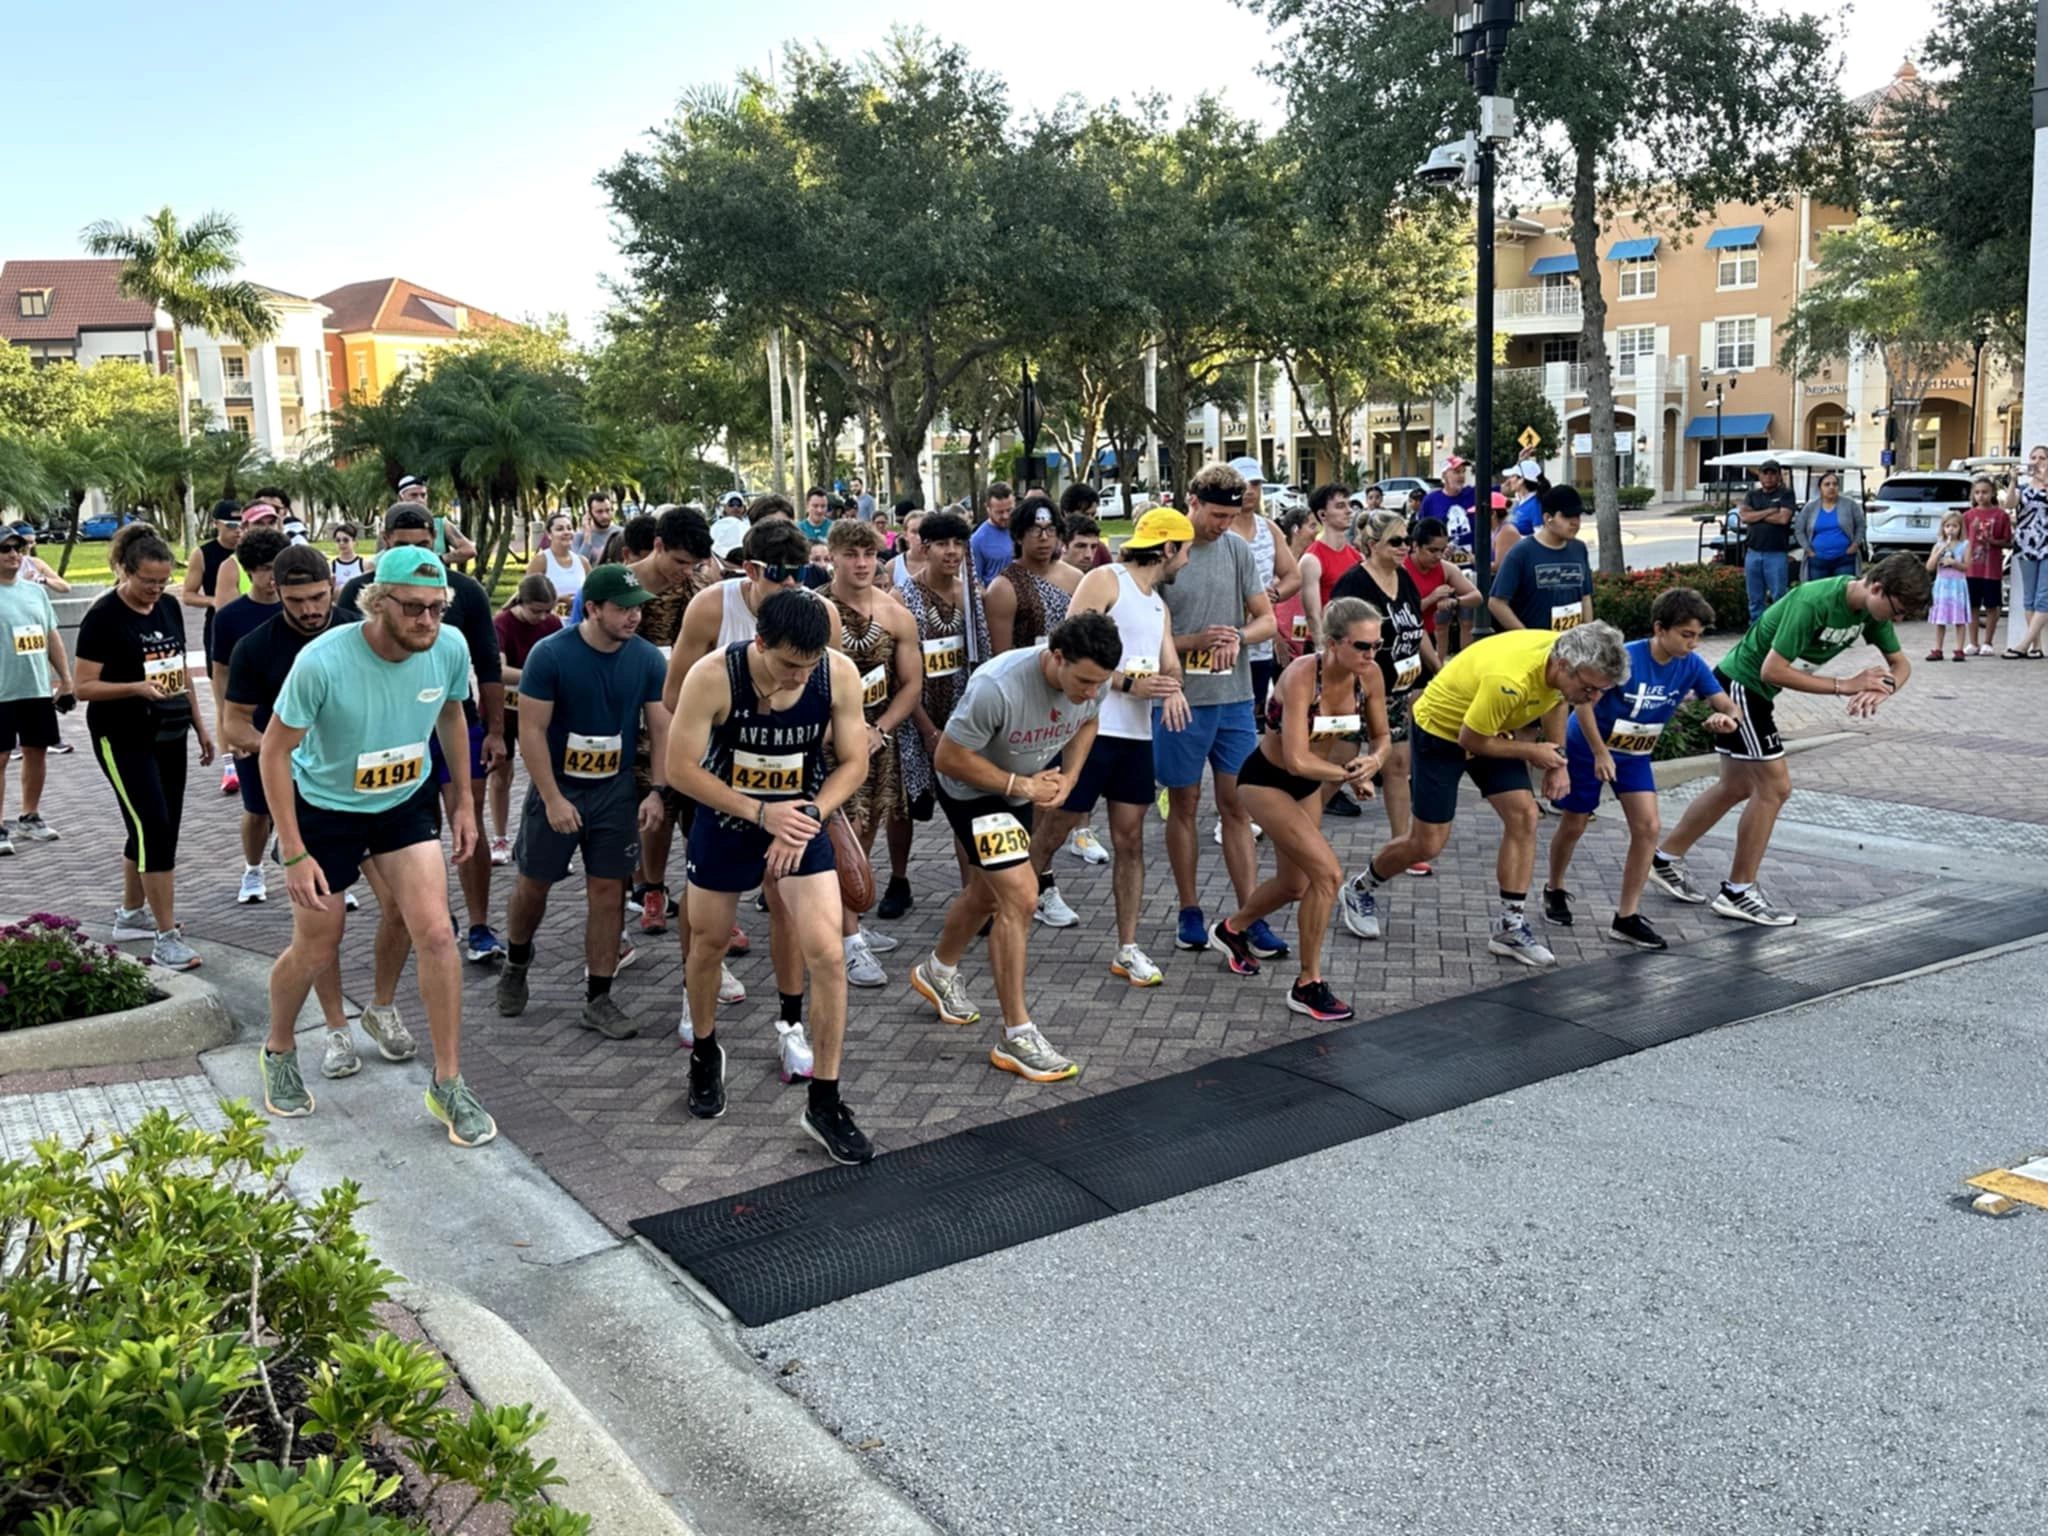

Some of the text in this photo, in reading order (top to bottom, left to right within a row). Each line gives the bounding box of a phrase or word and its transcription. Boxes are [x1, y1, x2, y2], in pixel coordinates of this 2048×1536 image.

[1941, 378, 1969, 390] HALL
[150, 669, 183, 692] 260
[864, 681, 885, 704] 190
[740, 726, 769, 746] AVE
[1608, 735, 1657, 751] 4208
[567, 750, 619, 771] 4244
[360, 760, 417, 788] 4191
[736, 767, 799, 789] 4204
[979, 828, 1029, 857] 4258
